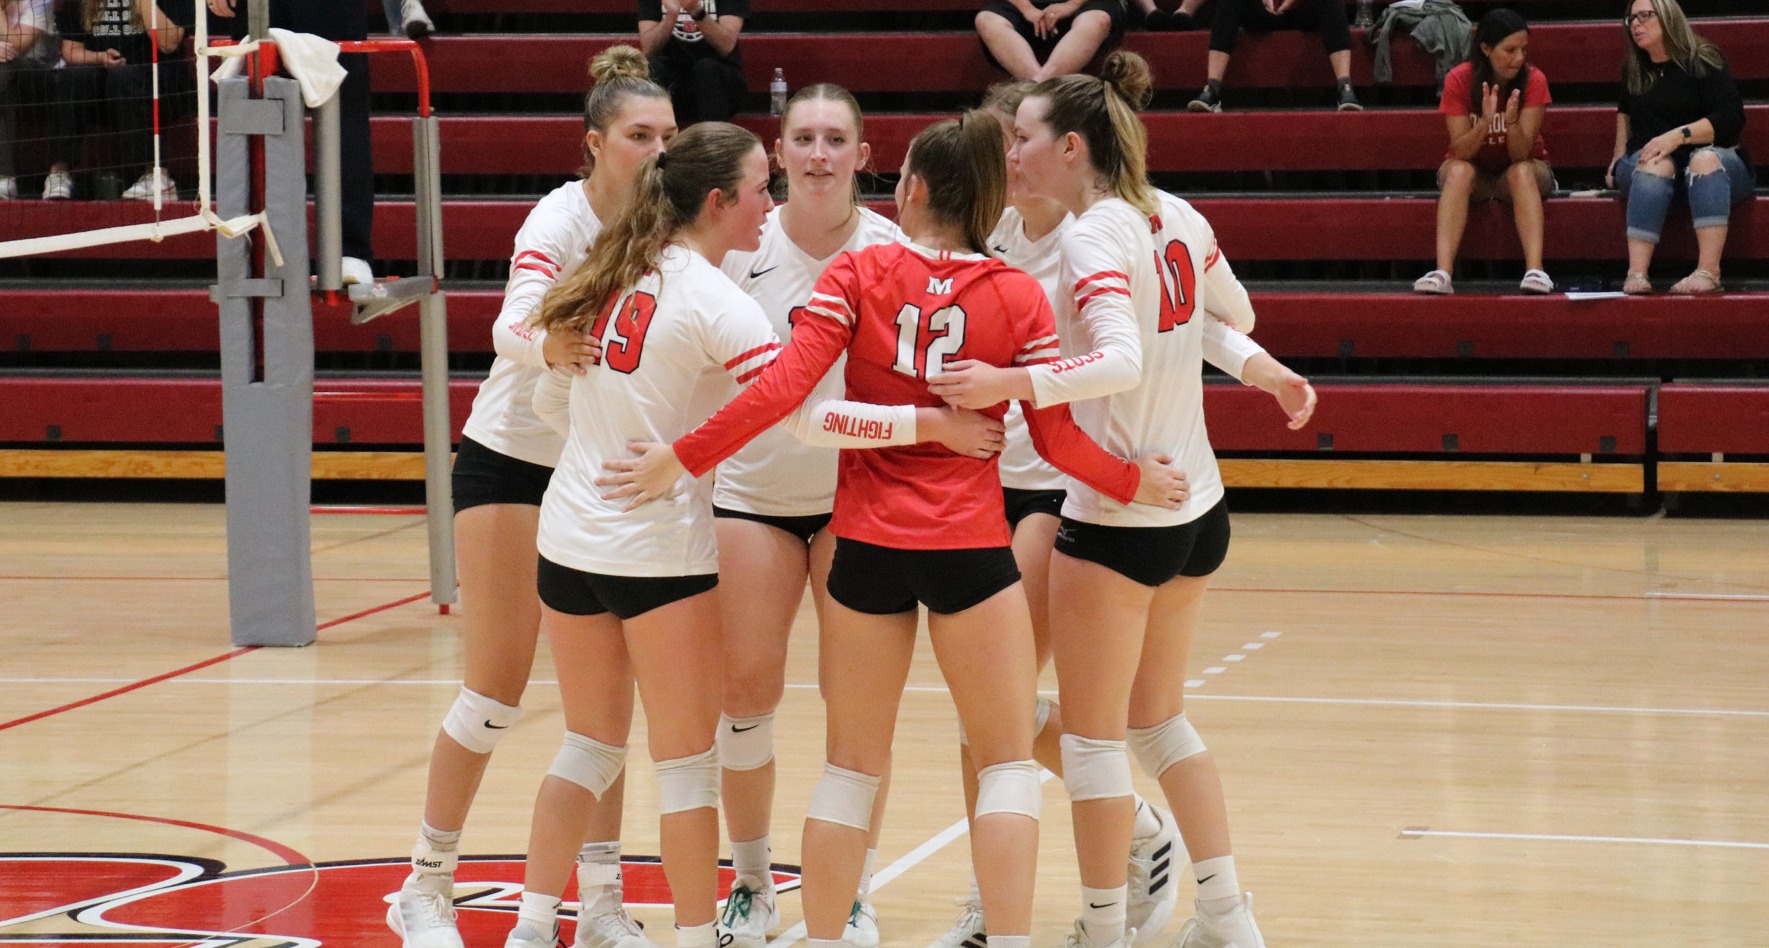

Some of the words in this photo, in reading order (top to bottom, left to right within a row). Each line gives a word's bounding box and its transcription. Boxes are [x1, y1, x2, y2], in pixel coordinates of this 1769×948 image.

[926, 275, 954, 295] M
[1153, 238, 1196, 333] 10
[891, 302, 967, 380] 12
[823, 411, 893, 440] FIGHTING
